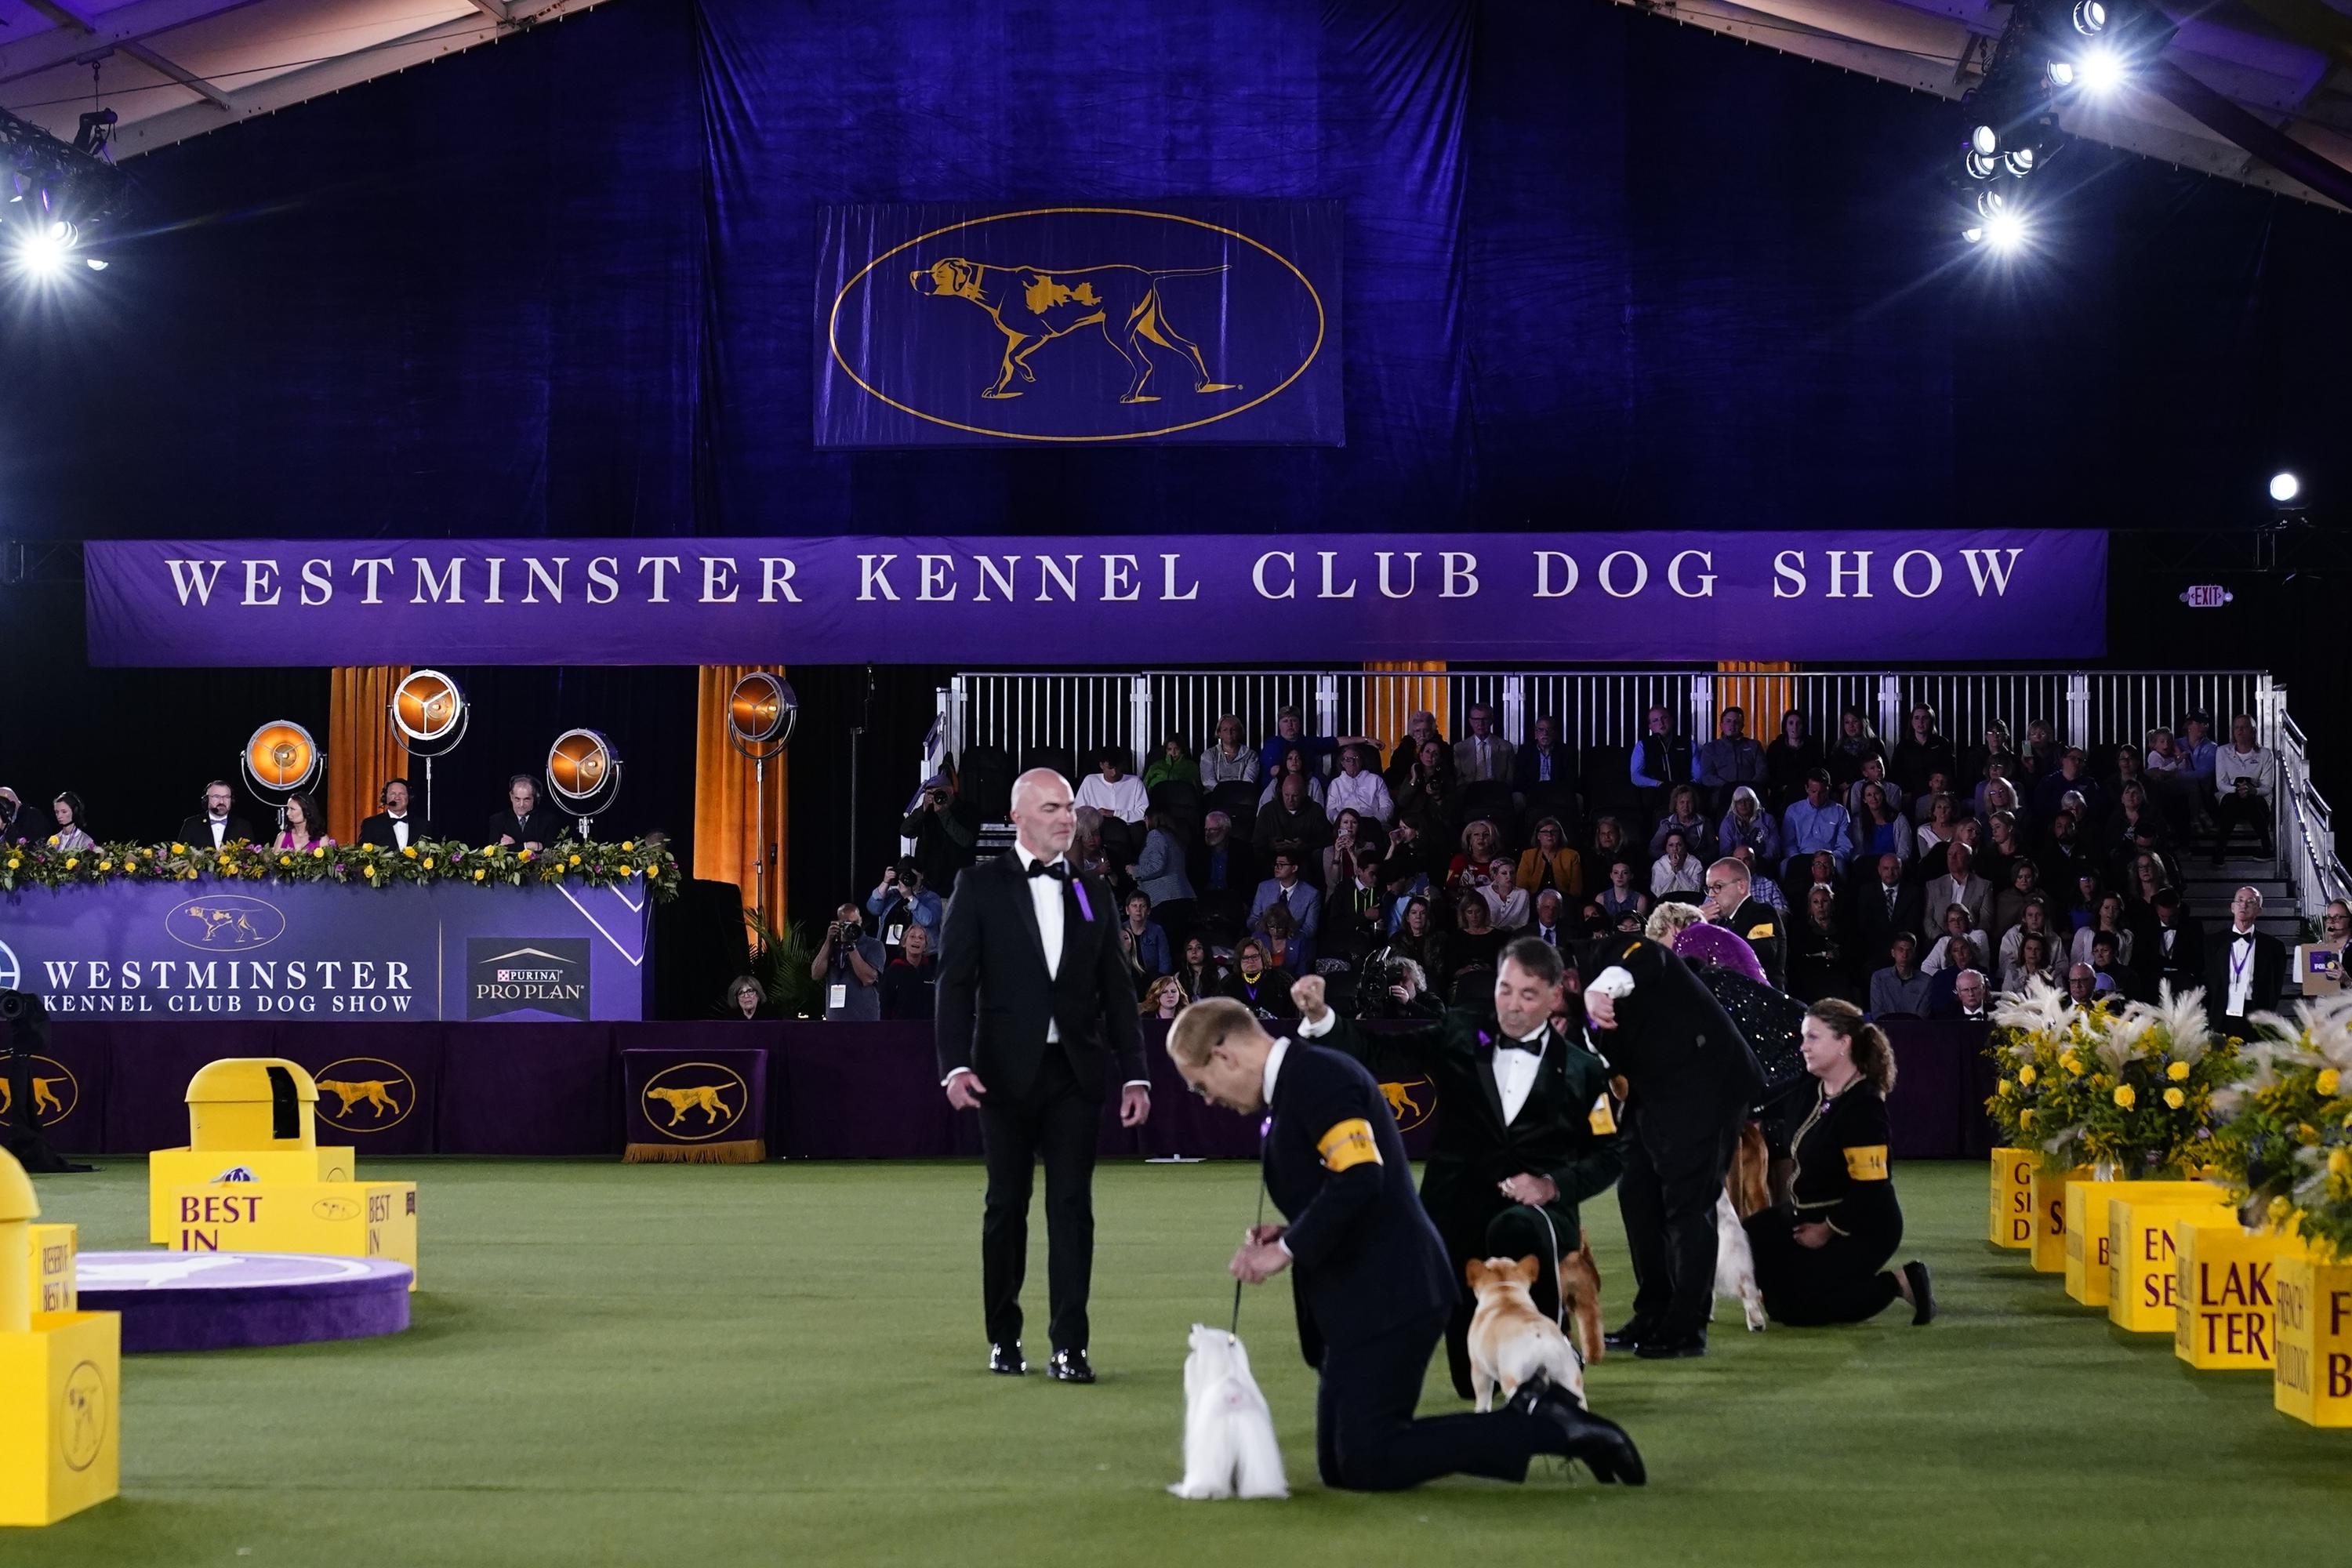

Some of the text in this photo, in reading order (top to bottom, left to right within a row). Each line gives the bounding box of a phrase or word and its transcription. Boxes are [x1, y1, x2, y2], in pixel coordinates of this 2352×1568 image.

[165, 548, 2024, 606] WESTMINSTER KENNEL CLUB DOG SHOW
[2195, 587, 2220, 605] EXIT
[43, 960, 412, 990] WESTMINSTER
[510, 971, 557, 981] PURINA
[43, 994, 412, 1012] KENNEL CLUB DOG SHOW
[476, 984, 581, 1000] PRO PLAN
[2014, 1161, 2031, 1185] G
[181, 1196, 263, 1224] BEST
[368, 1193, 391, 1224] BEST
[2050, 1200, 2067, 1236] S
[182, 1229, 219, 1253] IN
[368, 1227, 380, 1256] IN
[2013, 1218, 2031, 1241] D
[43, 1243, 69, 1276] RESERVE
[43, 1280, 60, 1313] BEST
[2144, 1273, 2177, 1308] SE
[2200, 1261, 2273, 1306] LAK
[2201, 1312, 2276, 1361] TER
